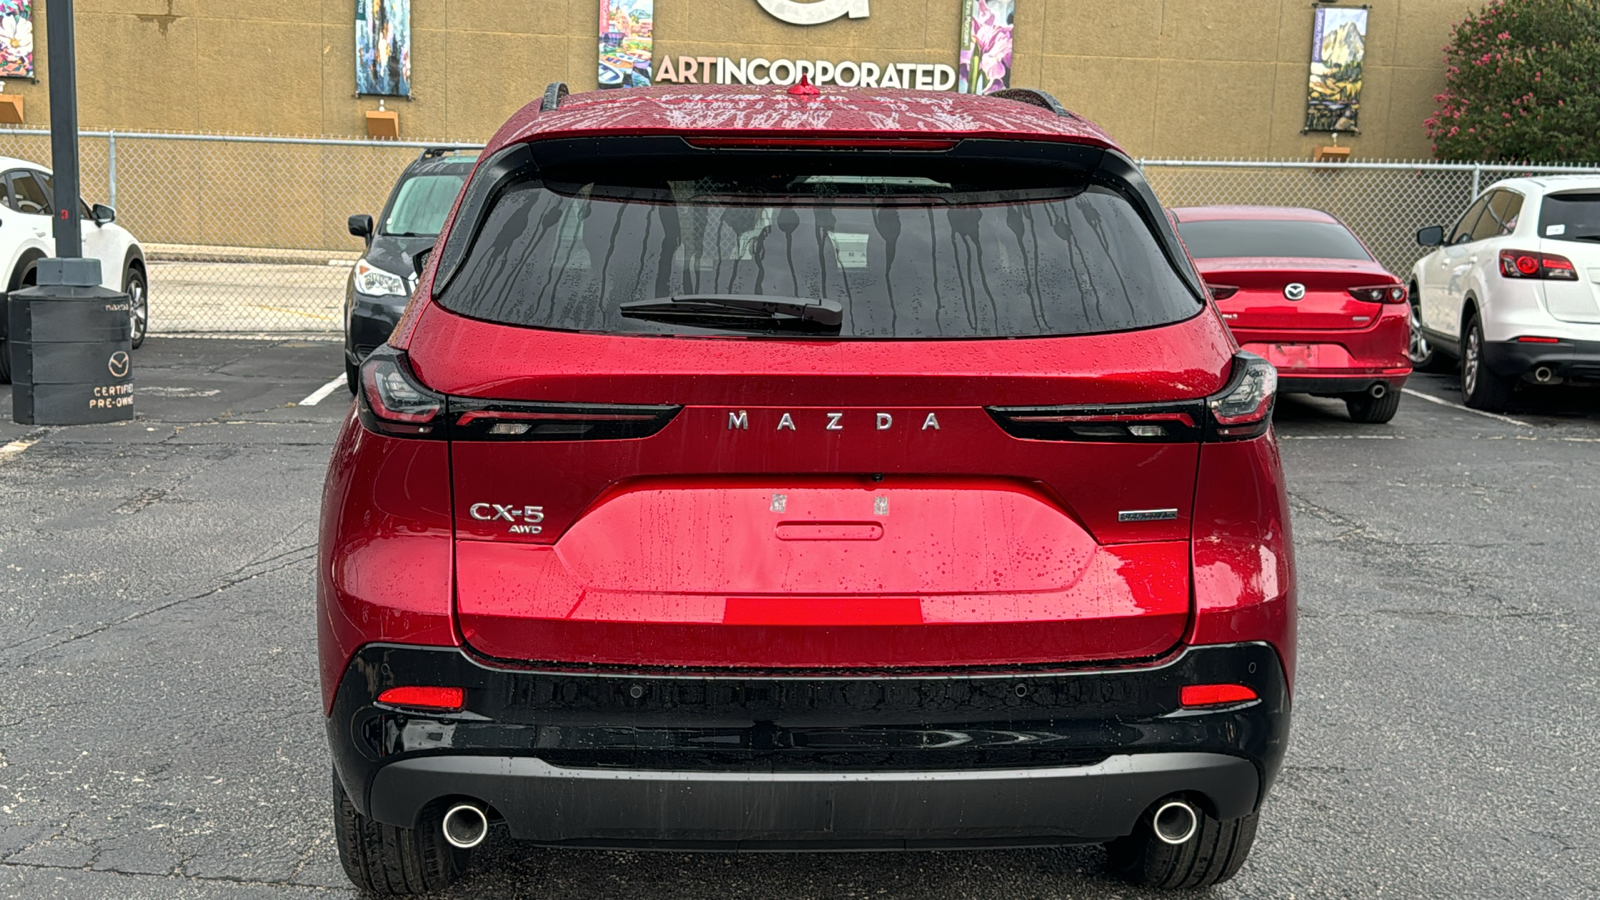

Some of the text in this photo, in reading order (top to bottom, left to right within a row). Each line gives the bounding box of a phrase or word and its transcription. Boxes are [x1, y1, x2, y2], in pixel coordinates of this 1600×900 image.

[728, 411, 940, 430] MAZDA
[469, 502, 545, 523] CX-5
[508, 524, 542, 534] AWD
